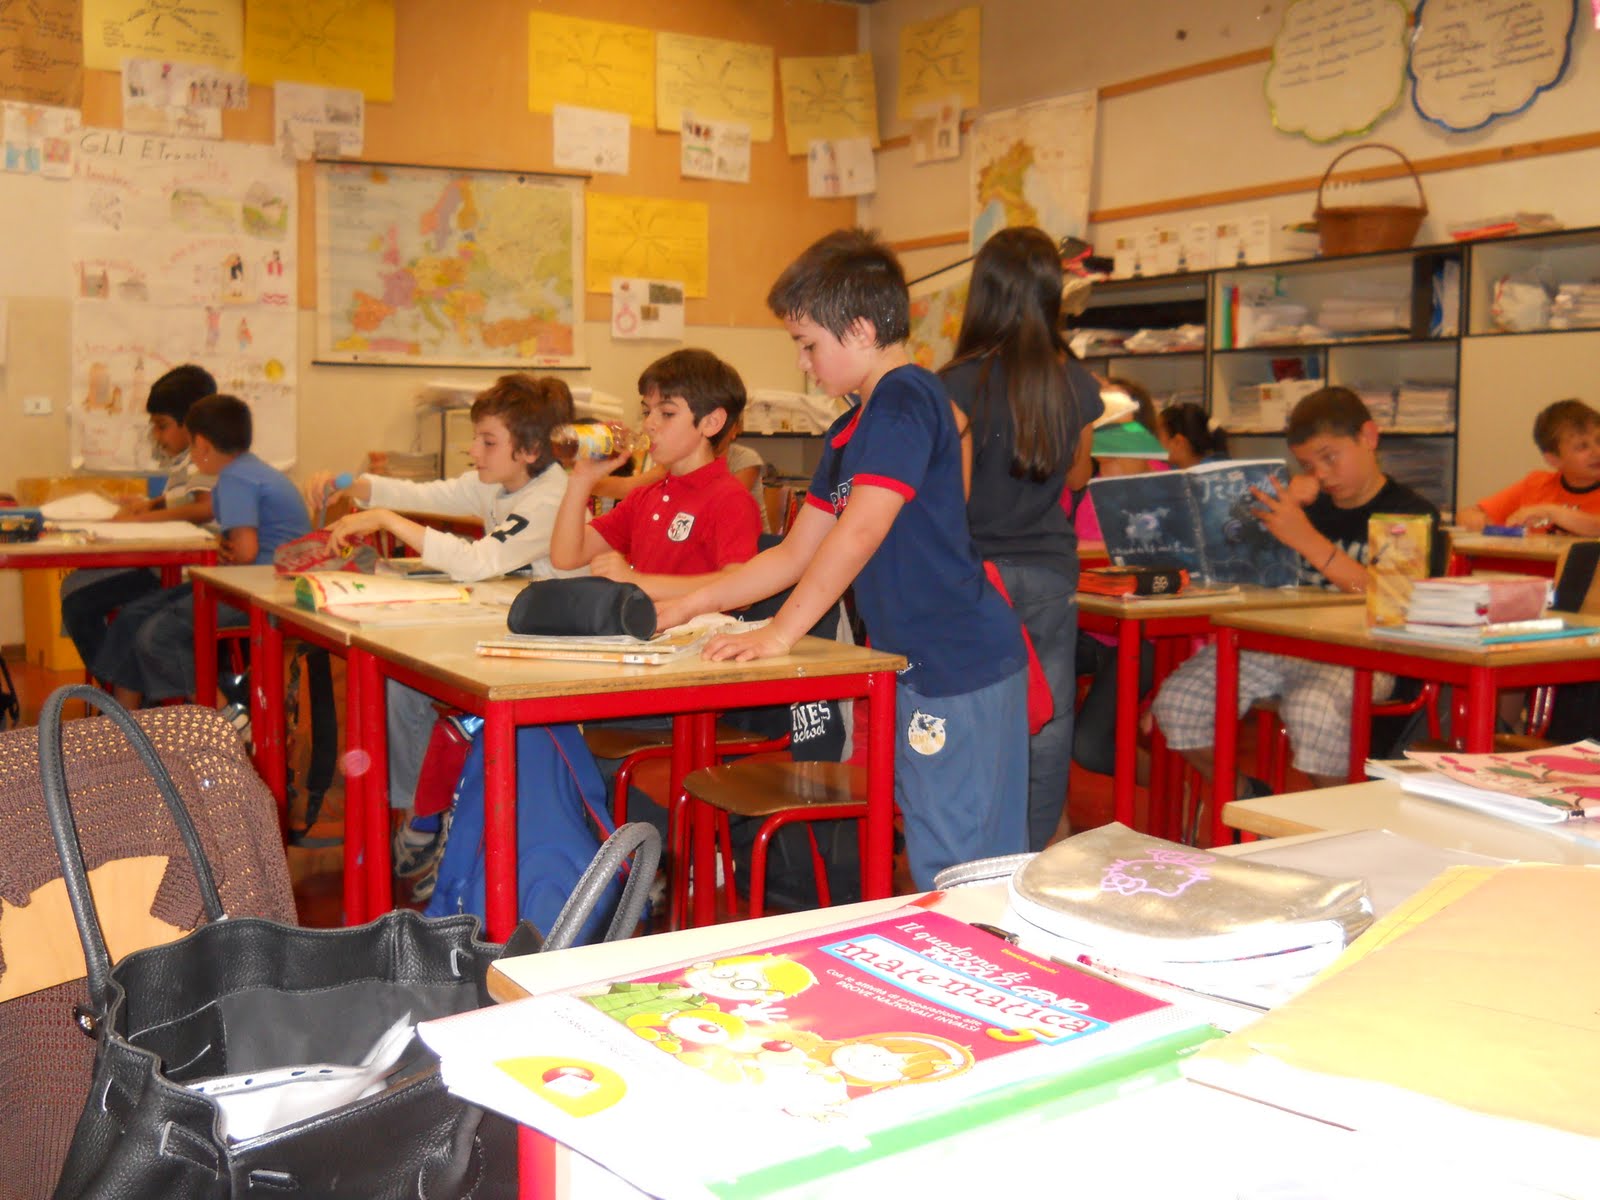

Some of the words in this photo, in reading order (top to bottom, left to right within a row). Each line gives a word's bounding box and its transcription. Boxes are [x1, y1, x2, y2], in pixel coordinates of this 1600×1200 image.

[80, 133, 125, 156] GLI
[793, 719, 827, 743] school
[895, 921, 925, 934] Il
[912, 931, 1003, 972] quaderno
[1001, 971, 1031, 984] di
[834, 942, 1092, 1033] matematica
[836, 980, 875, 998] PROVE
[985, 1026, 1059, 1043] 5
